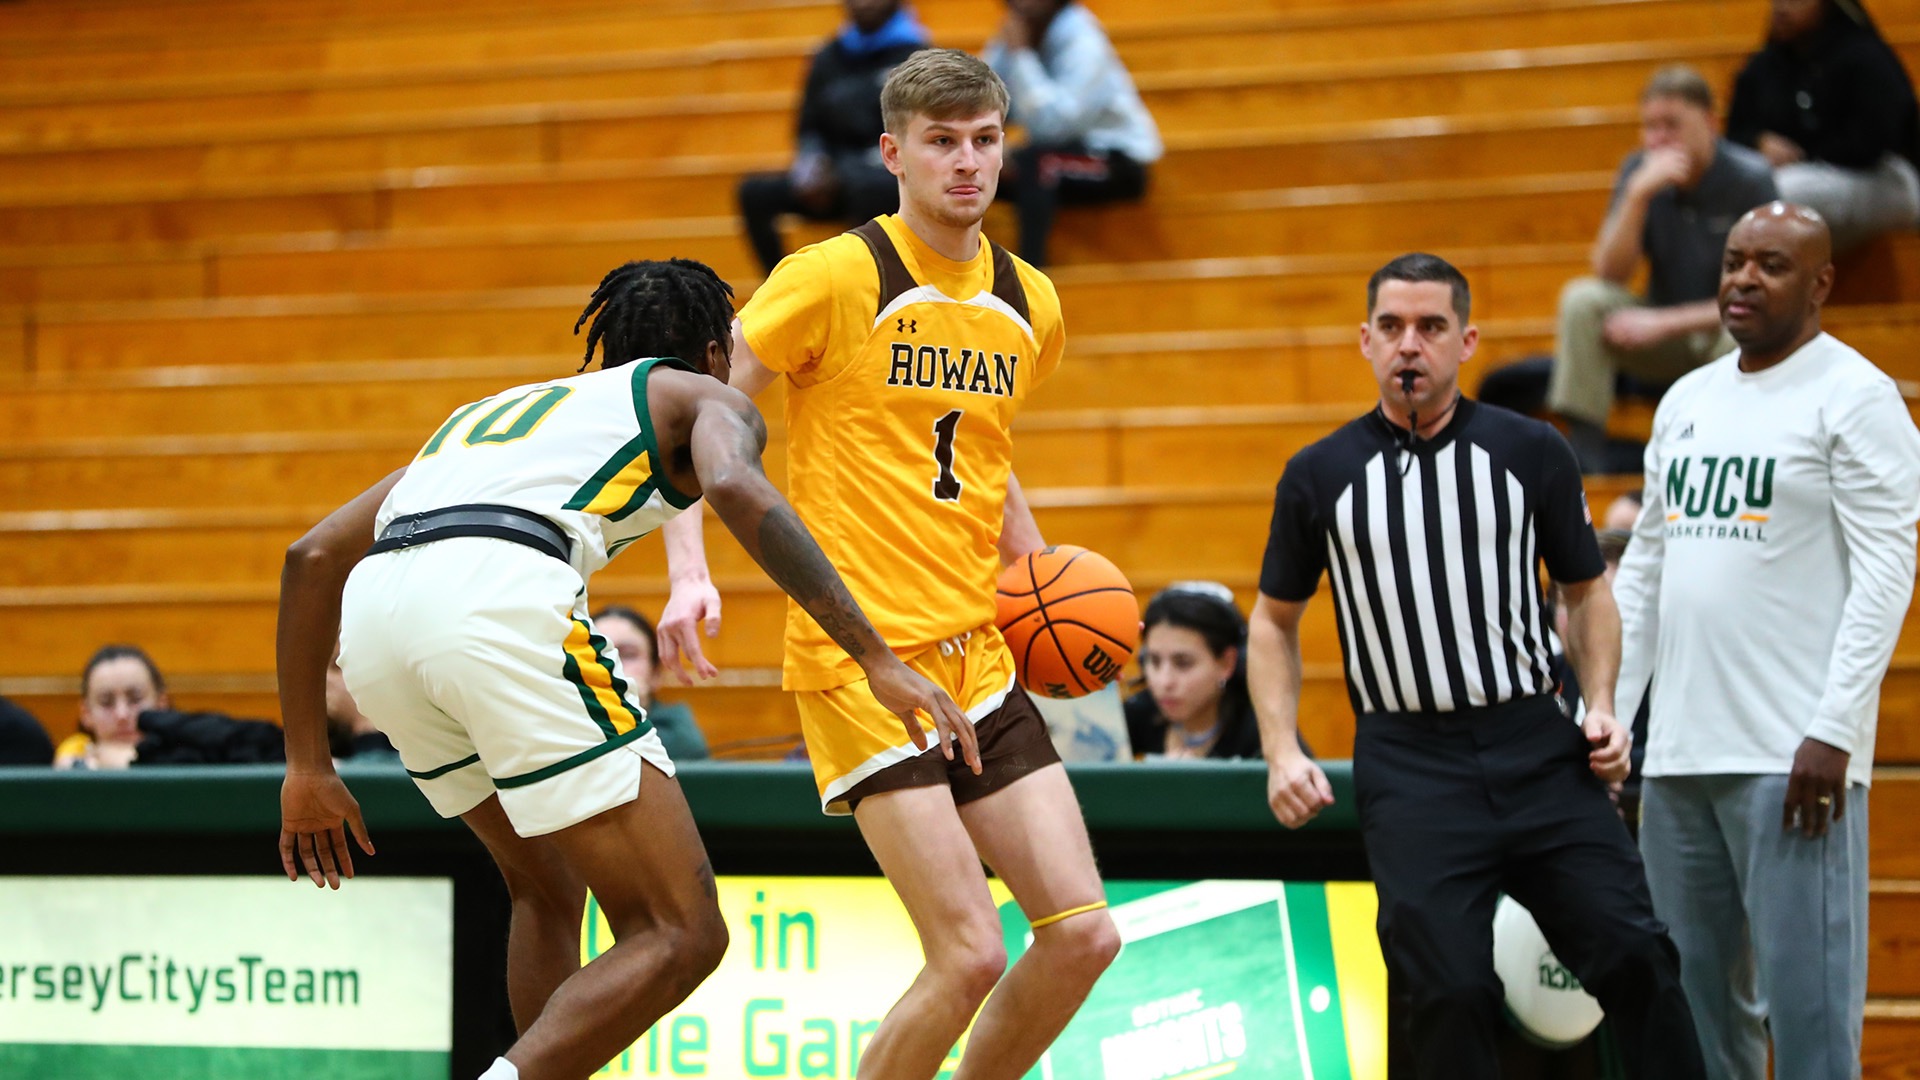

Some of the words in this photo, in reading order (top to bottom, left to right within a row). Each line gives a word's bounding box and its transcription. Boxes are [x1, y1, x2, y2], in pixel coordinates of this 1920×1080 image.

[886, 342, 1018, 398] ROWAN
[416, 385, 576, 462] 10
[931, 408, 964, 503] 1
[1666, 456, 1776, 519] NJCU
[1666, 524, 1767, 543] ASKETBALL
[749, 890, 816, 970] in
[0, 953, 360, 1014] rseyCitysTeam
